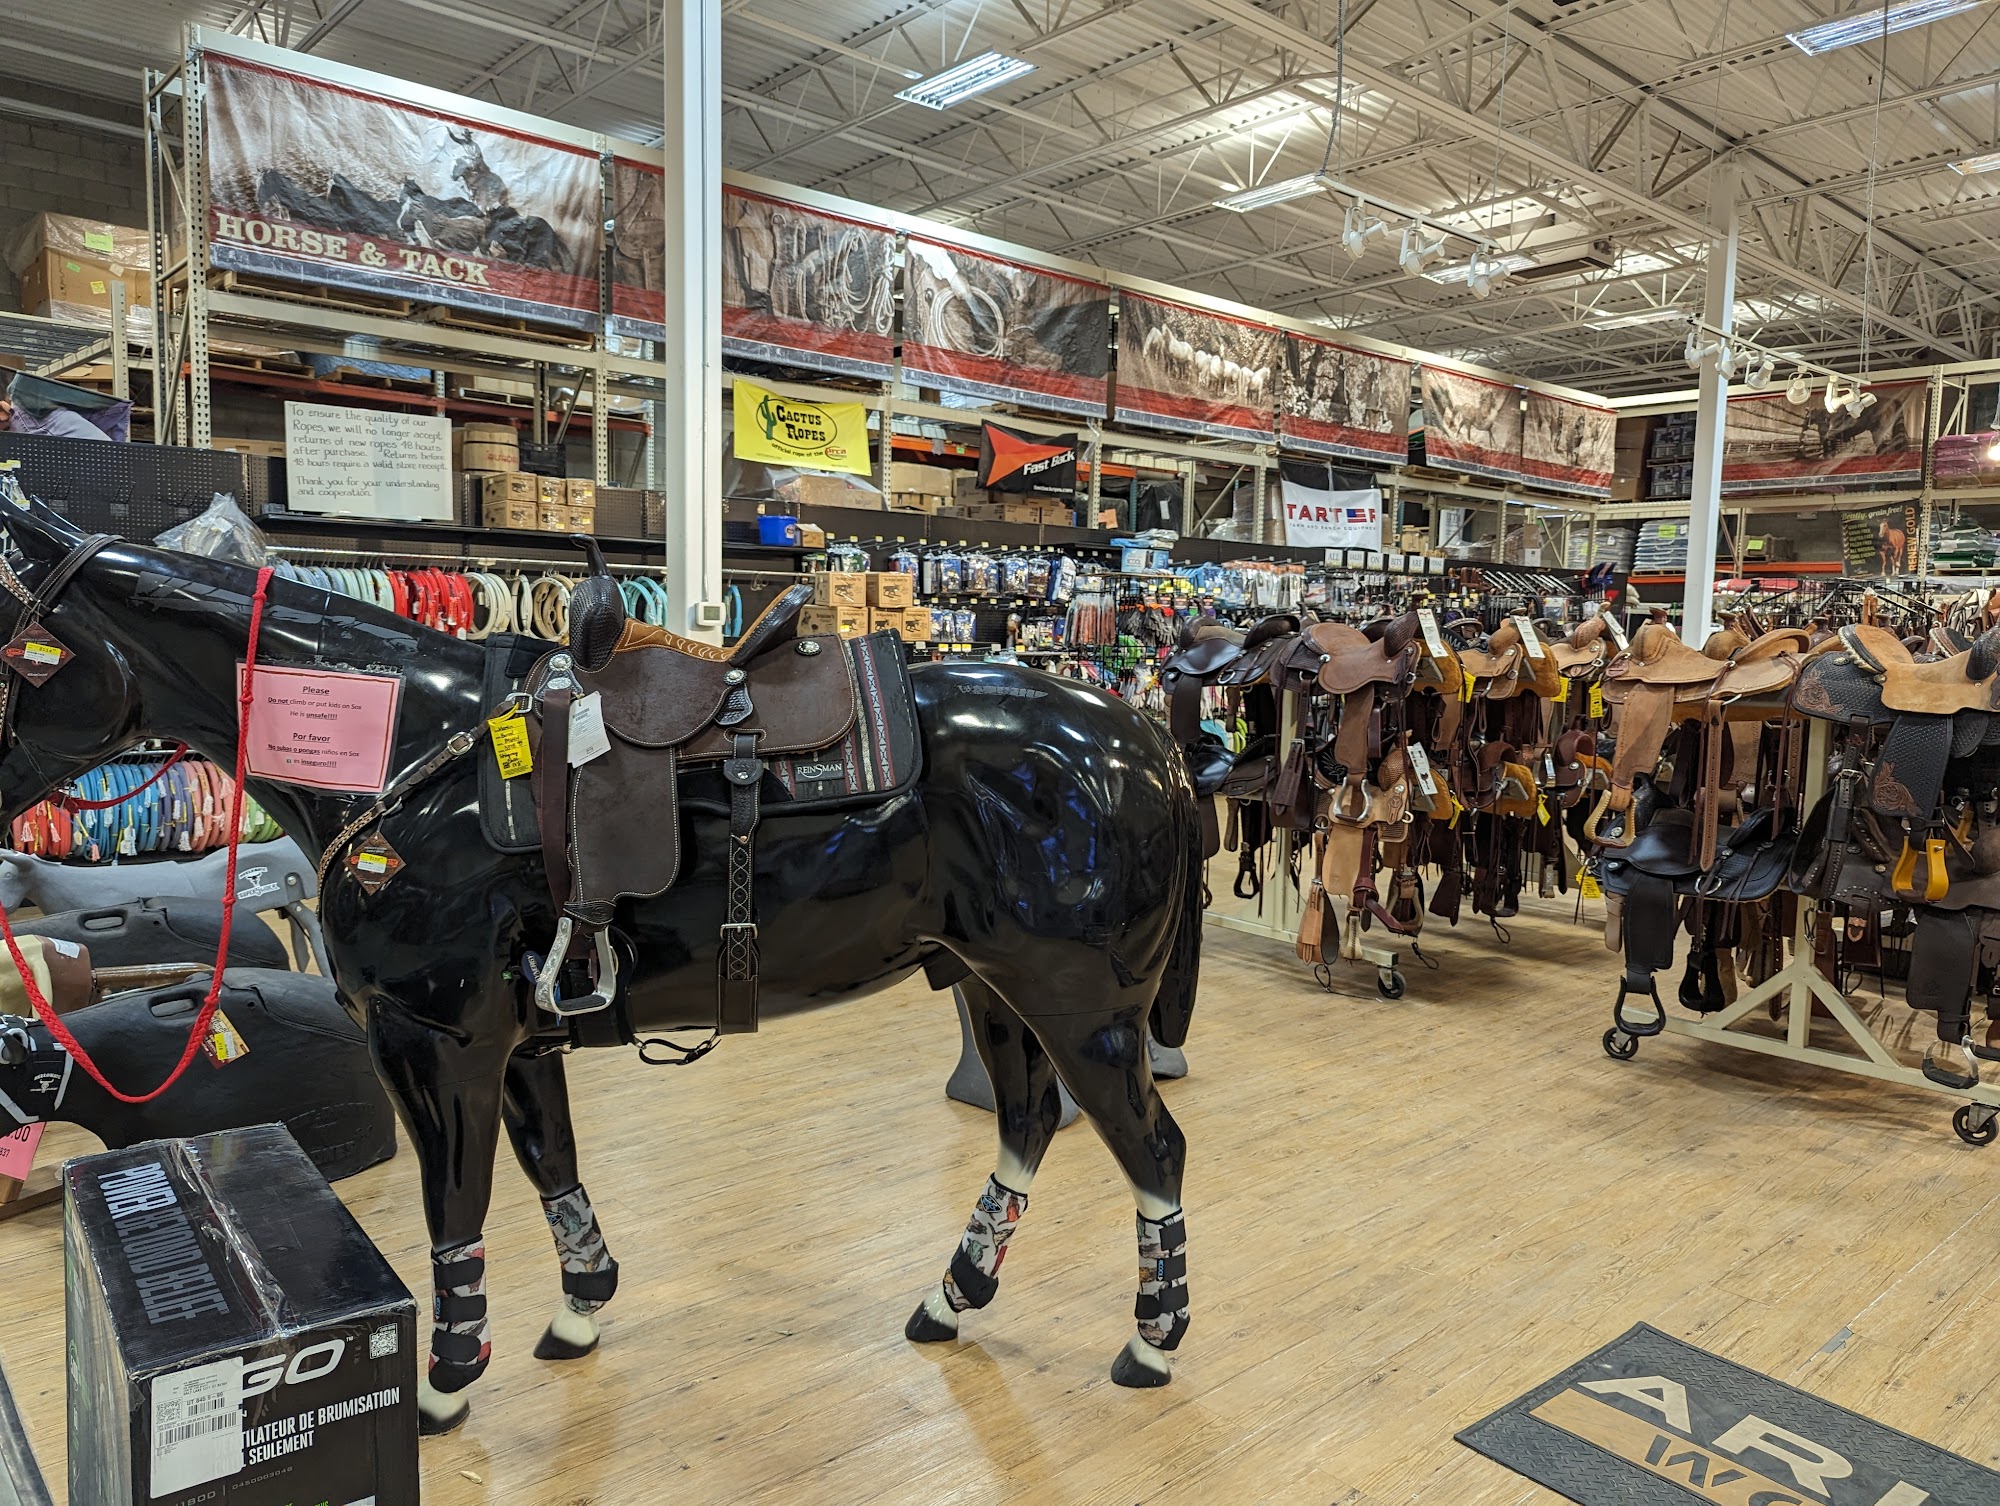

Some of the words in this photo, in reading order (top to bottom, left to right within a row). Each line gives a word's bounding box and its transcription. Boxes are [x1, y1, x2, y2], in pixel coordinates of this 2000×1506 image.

[216, 212, 348, 260] HORSE
[359, 242, 387, 267] &
[401, 249, 490, 286] TACK
[289, 403, 303, 416] To
[308, 410, 341, 419] ensure
[346, 410, 361, 421] the
[366, 413, 398, 427] quality
[413, 419, 428, 427] our
[328, 425, 341, 433] we
[345, 426, 362, 434] will
[382, 427, 411, 441] longer
[414, 432, 442, 443] accept
[294, 435, 331, 444] returns
[335, 437, 343, 445] of
[349, 439, 366, 447] new
[370, 440, 397, 452] ropes
[415, 442, 442, 451] hours
[772, 443, 791, 454] official
[293, 446, 320, 455] after
[324, 449, 368, 460] purchase.
[384, 450, 417, 459] Returns
[333, 461, 361, 471] require
[373, 459, 393, 469] valid
[1023, 460, 1050, 475] Fast
[1051, 450, 1075, 467] Back
[297, 476, 324, 486] Thank
[328, 479, 343, 489] you
[347, 477, 359, 486] for
[363, 480, 382, 490] your
[386, 480, 439, 491] understanding
[318, 489, 372, 499] cooperation.
[1868, 509, 1886, 519] grain
[1887, 505, 1903, 516] free!
[1905, 507, 1915, 535] GOLD
[1907, 538, 1917, 571] RENEW
[302, 686, 330, 695] Please
[308, 734, 331, 742] favor
[299, 747, 320, 755] pongas
[797, 763, 842, 778] REINSMAN
[98, 1162, 177, 1219] POWER
[115, 1207, 202, 1274] BEYOND
[135, 1263, 230, 1325] BELIEF
[299, 1411, 314, 1431] DE
[318, 1387, 400, 1427] BRUMISATION
[249, 1431, 314, 1465] SEULEMENT
